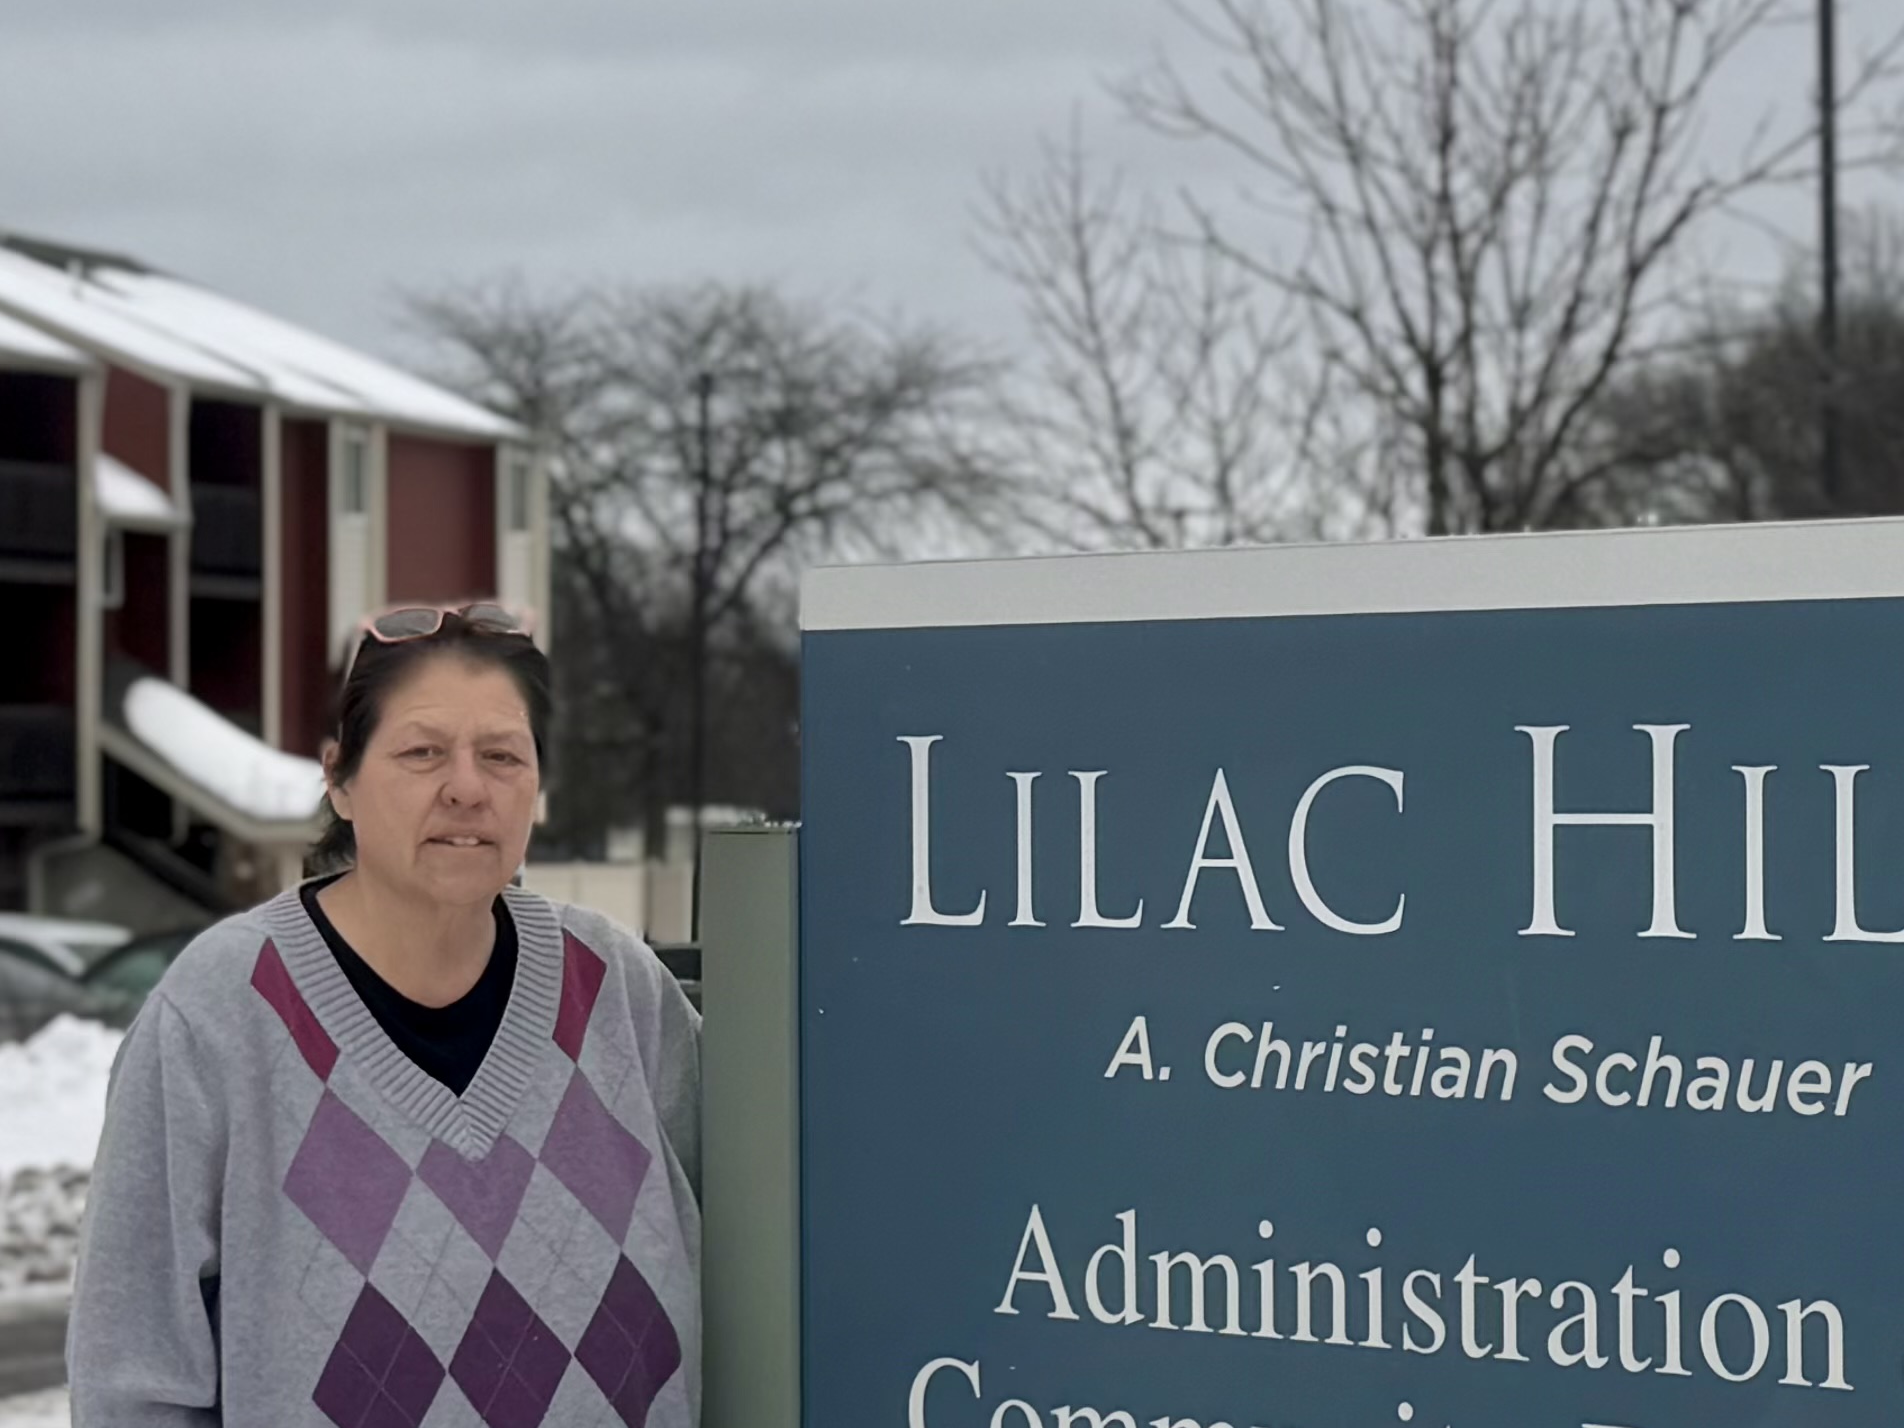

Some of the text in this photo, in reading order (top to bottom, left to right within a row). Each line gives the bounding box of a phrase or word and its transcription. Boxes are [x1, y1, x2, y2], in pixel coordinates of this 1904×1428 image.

[1103, 1015, 1873, 1118] A. Christian Schauer
[993, 1203, 1854, 1392] Administration
